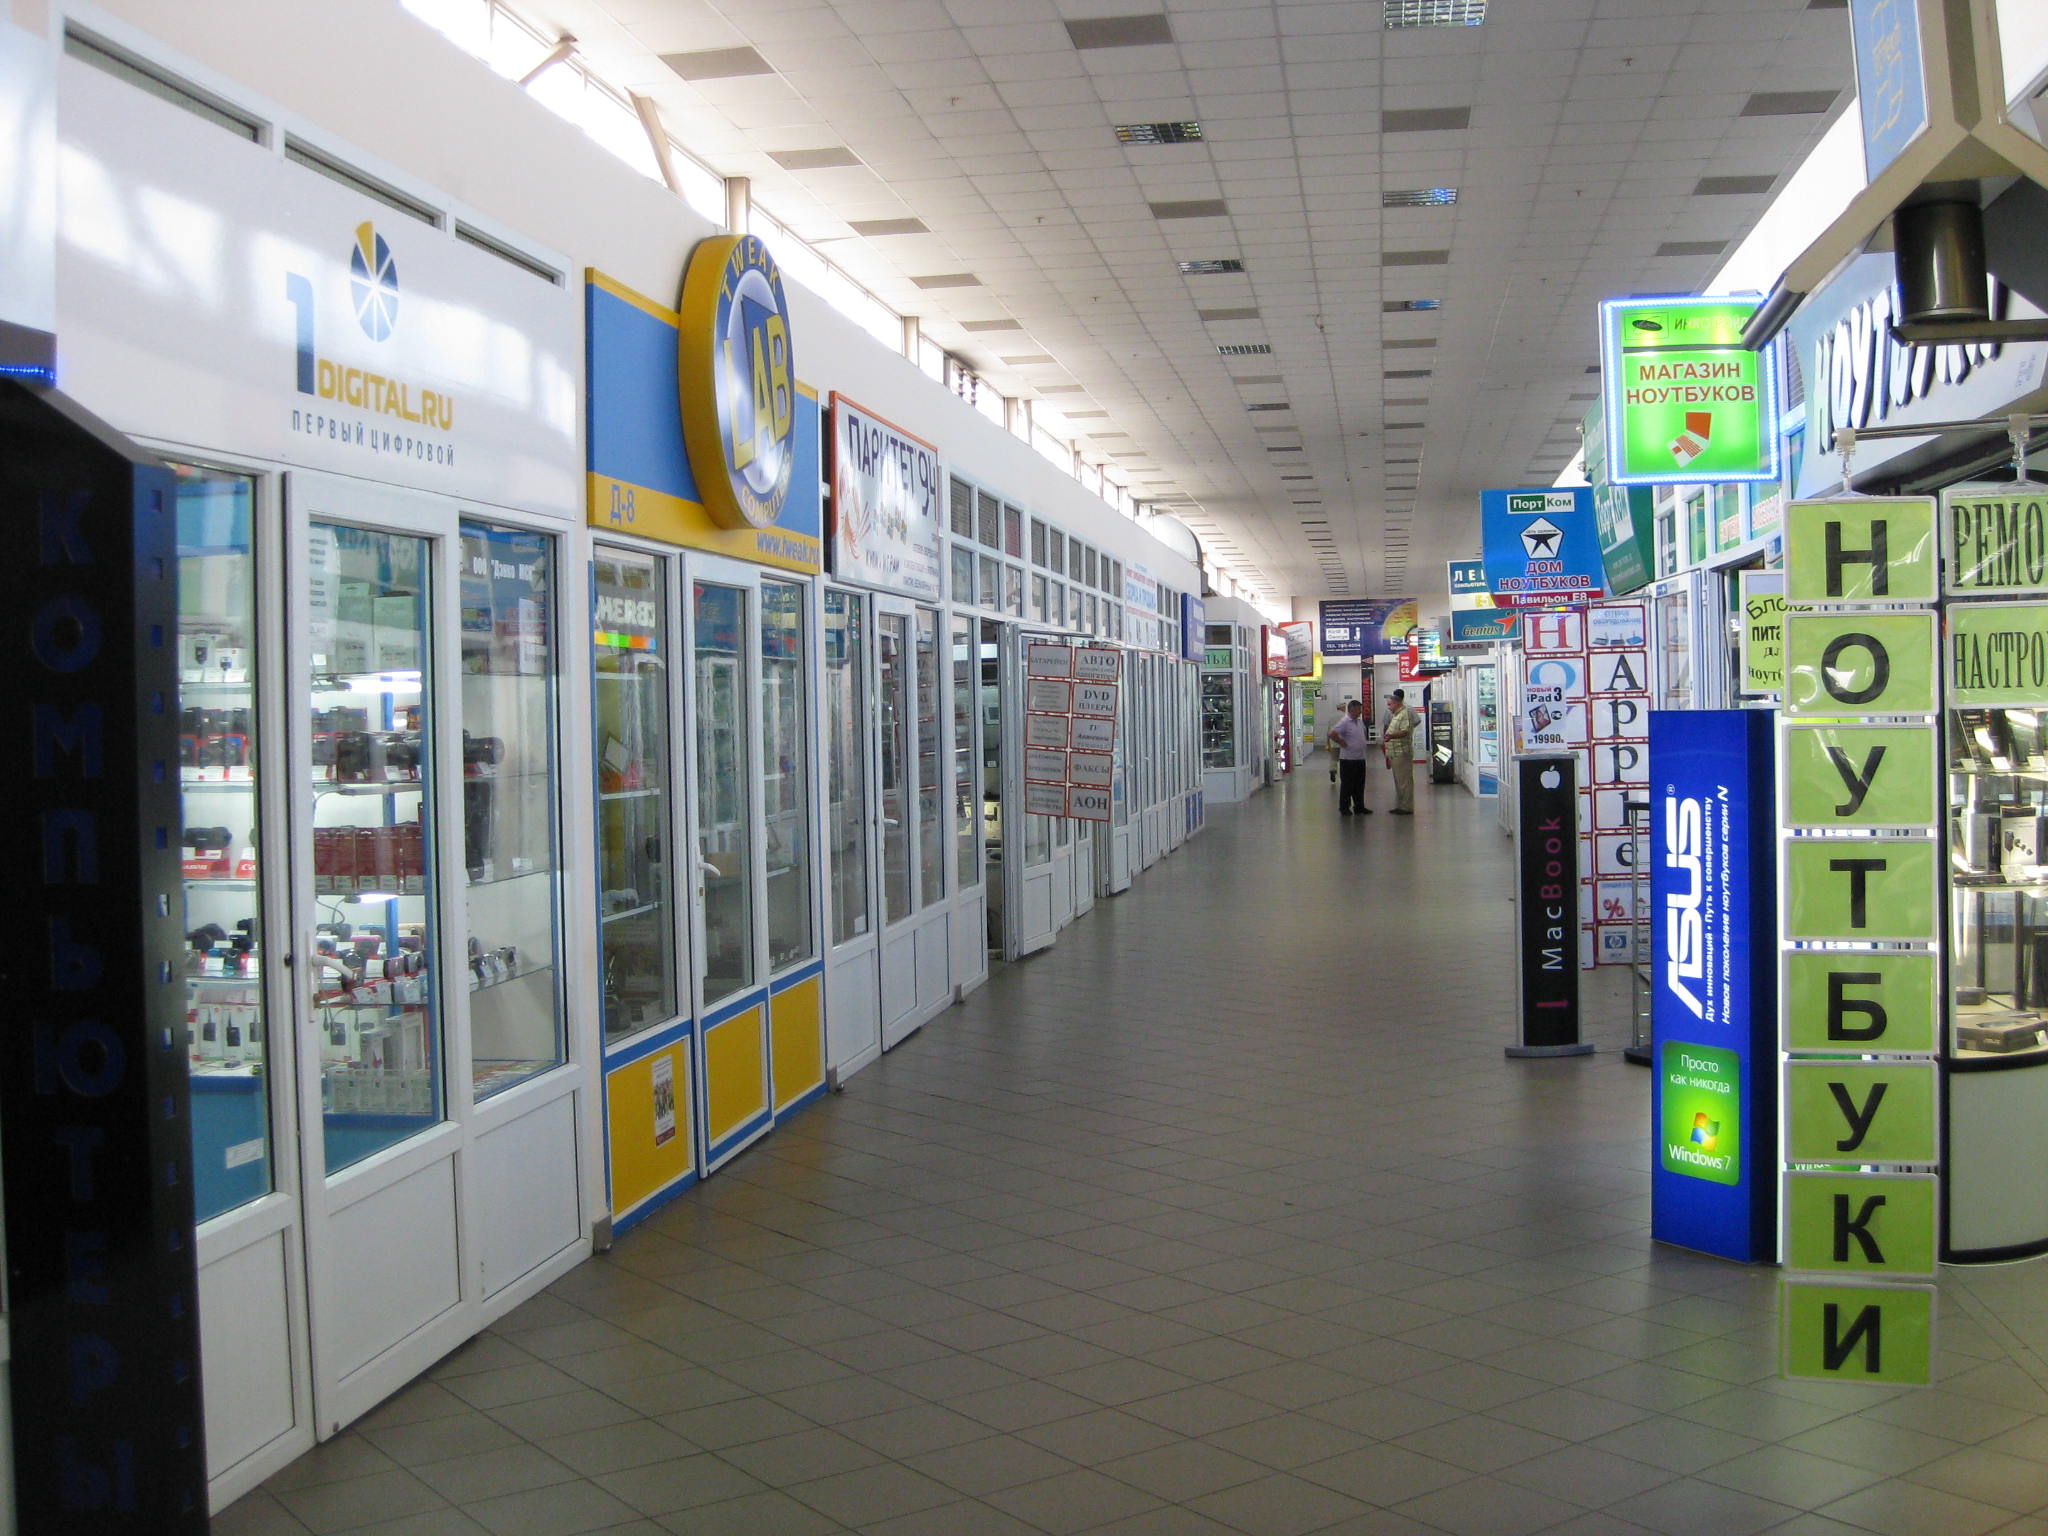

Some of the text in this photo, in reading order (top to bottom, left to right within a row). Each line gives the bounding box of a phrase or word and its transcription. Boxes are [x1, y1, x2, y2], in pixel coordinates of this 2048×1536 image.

[721, 237, 779, 302] TWEAK
[286, 271, 453, 431] 1 DIGITAL.RU
[1639, 362, 1741, 381] МАГАЗИН
[723, 313, 791, 473] LAB
[1626, 385, 1756, 405] НОУТБУКОВ
[292, 409, 455, 467] ПЕРВЫЙ ЦИФРОВОЙ
[610, 483, 636, 525] Д-8
[1513, 497, 1572, 511] Порт Ком
[1950, 502, 2048, 588] РЕМО
[1499, 575, 1591, 590] НОУТБУКОВ
[1526, 561, 1563, 575] ДОМ
[1511, 595, 1568, 605] Павильон
[1462, 625, 1499, 636] Genius
[1953, 631, 2048, 690] НАСТРО
[1084, 689, 1109, 701] DVD
[1527, 687, 1562, 703] iPad 3
[1073, 764, 1110, 774] ФАКСЫ
[1073, 795, 1108, 810] АОН
[1720, 803, 1731, 842] серии
[1704, 796, 1714, 882] совершенству
[1540, 816, 1563, 971] MacBook
[1720, 843, 1731, 912] ноутбуков
[1666, 797, 1703, 1020] ASUS
[1721, 912, 1731, 982] поколение
[1821, 519, 1890, 1374] НОУТБУКИ
[31, 488, 136, 1513] КОМПЬЮТЕРЫ
[1721, 984, 1731, 1025] Новое
[1670, 1073, 1730, 1094] как никогда
[1680, 1054, 1719, 1073] Просто
[1668, 1143, 1732, 1171] Windows 7
